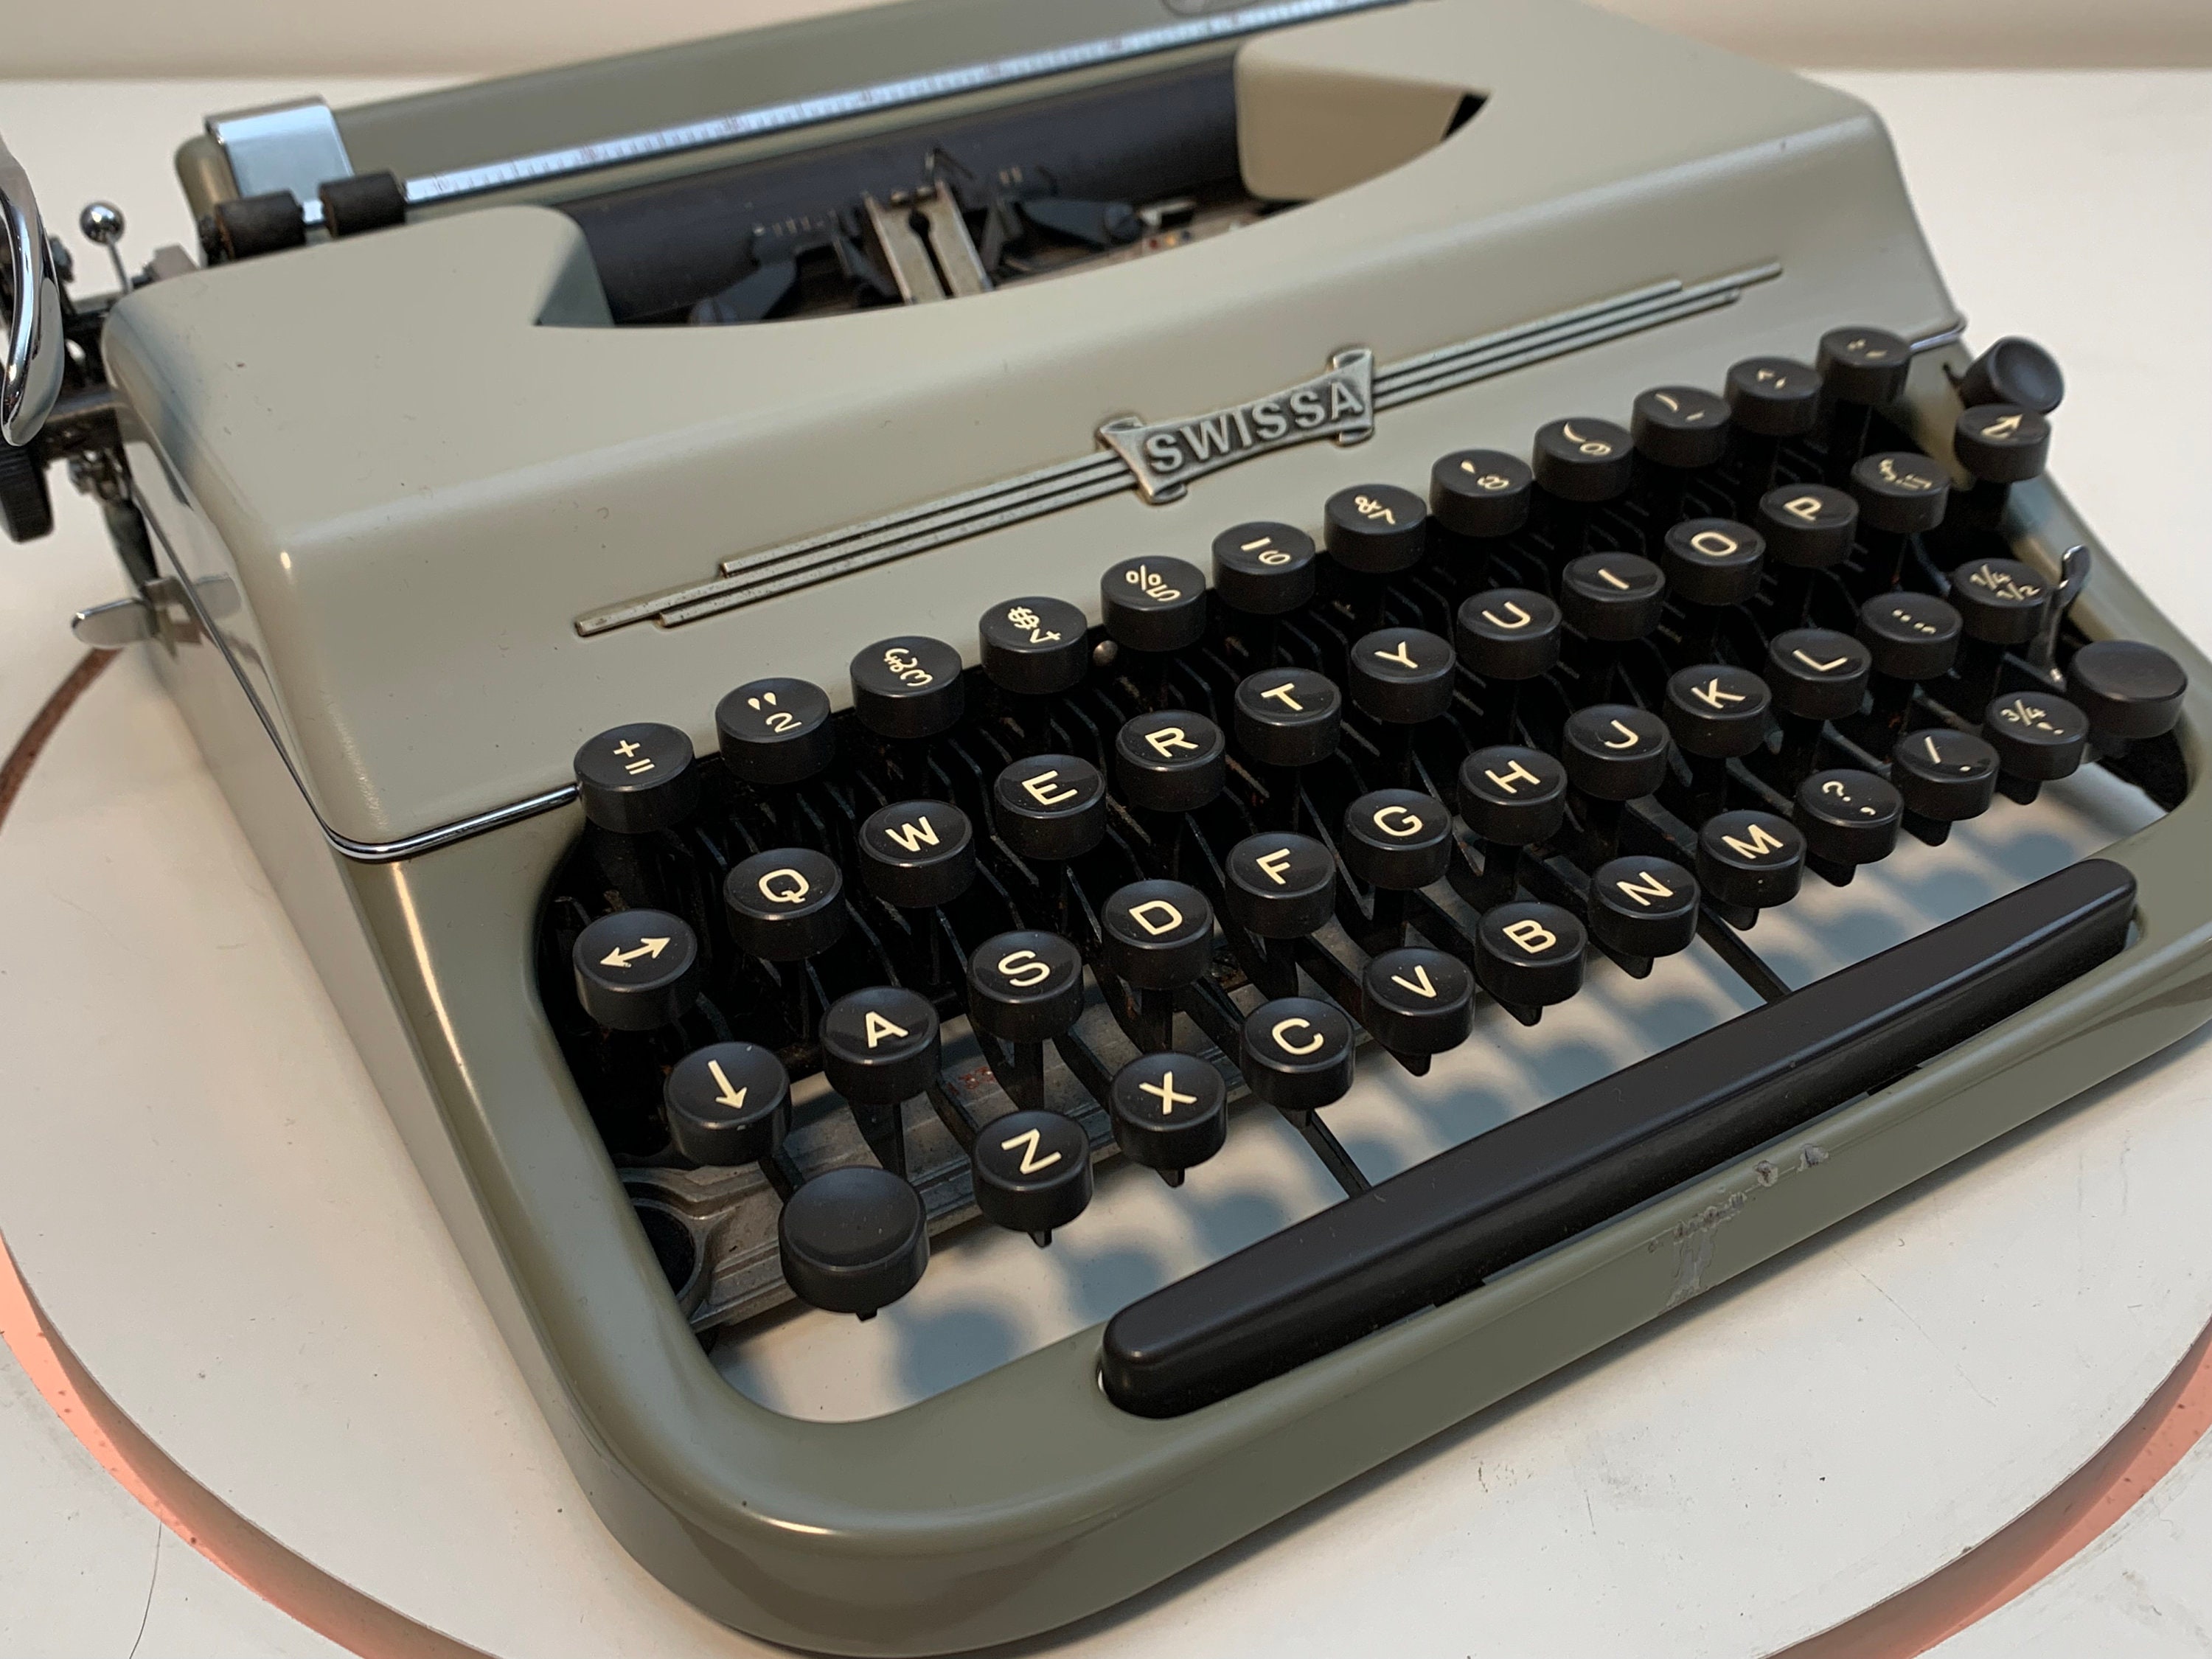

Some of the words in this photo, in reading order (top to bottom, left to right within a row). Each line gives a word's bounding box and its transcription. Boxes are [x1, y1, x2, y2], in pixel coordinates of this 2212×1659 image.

[1146, 380, 1364, 473] SWISSA
[1579, 442, 1612, 456] 9
[1477, 475, 1510, 491] 8
[1354, 495, 1383, 515] &
[1368, 508, 1396, 525] 7
[1784, 496, 1823, 521] P
[1258, 549, 1291, 566] 6
[1691, 531, 1738, 557] O
[1125, 565, 1163, 592] %
[1597, 568, 1630, 590] I
[1146, 585, 1181, 602] 5
[1007, 606, 1040, 630] $
[1481, 601, 1531, 629] U
[1029, 627, 1061, 644] 4
[883, 647, 919, 673] £
[1375, 641, 1419, 669] Y
[1792, 650, 1848, 672] L
[900, 669, 934, 687] 3
[1260, 683, 1304, 711] T
[1691, 678, 1747, 709] K
[765, 712, 802, 733] 2
[1604, 720, 1640, 749] J
[613, 740, 641, 758] +
[1144, 727, 1199, 758] R
[1021, 770, 1078, 806] E
[1484, 760, 1542, 794] H
[1822, 780, 1851, 802] ?
[885, 816, 940, 852] W
[1373, 806, 1424, 837] G
[1722, 824, 1784, 859] M
[1256, 848, 1292, 885] F
[759, 869, 810, 904] Q
[1616, 872, 1674, 906] N
[1128, 900, 1183, 936] D
[1502, 919, 1557, 953] B
[998, 950, 1051, 987] S
[1391, 965, 1438, 998] V
[865, 1011, 909, 1048] A
[1272, 1018, 1325, 1055] C
[1138, 1071, 1198, 1115] X
[1001, 1129, 1062, 1175] Z
